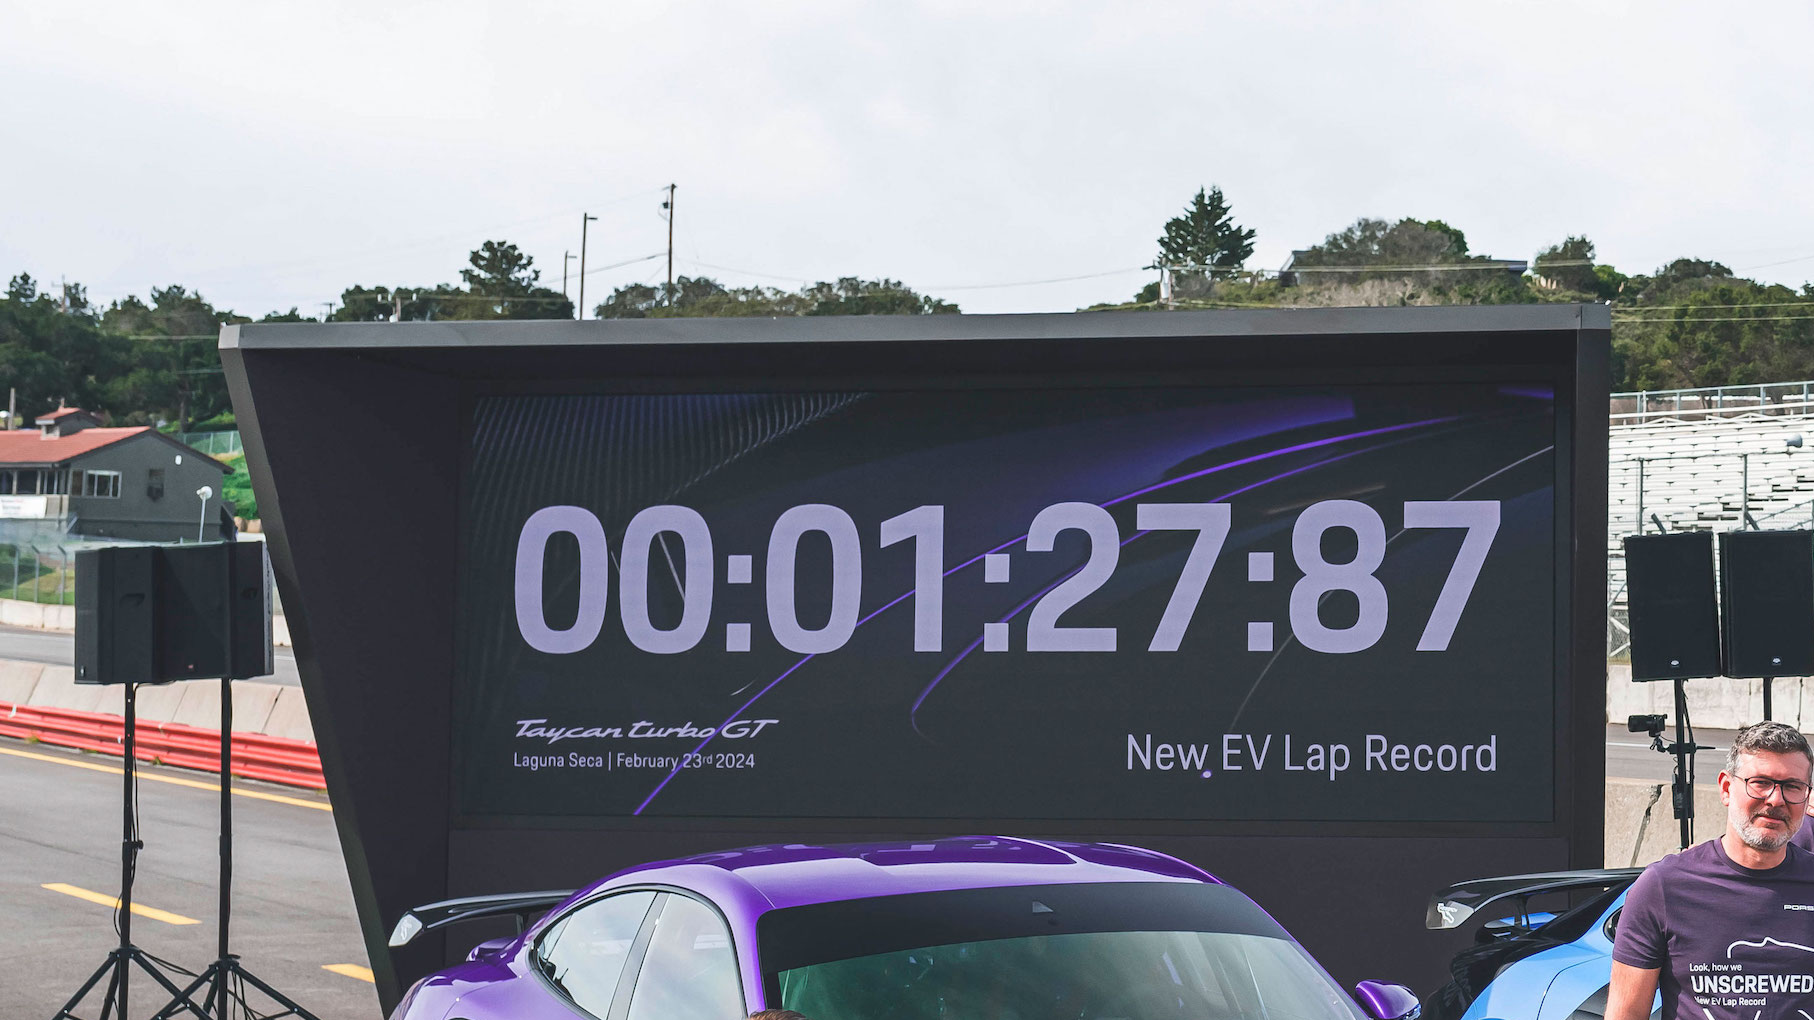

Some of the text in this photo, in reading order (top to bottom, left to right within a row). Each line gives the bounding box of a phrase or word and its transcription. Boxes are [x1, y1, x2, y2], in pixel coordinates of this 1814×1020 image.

[514, 500, 1501, 655] 00:01:27:87
[515, 719, 780, 745] Taycan turbo GT
[513, 752, 565, 771] Laguna
[568, 752, 603, 768] Seca
[616, 752, 679, 771] February
[716, 753, 755, 769] 2024
[1126, 733, 1497, 781] New EV Lap Record
[1689, 963, 1711, 972] Look,
[1712, 963, 1729, 971] how
[1690, 975, 1814, 993] UNSCREWED
[1711, 997, 1721, 1005] EV
[1722, 997, 1737, 1007] Lap
[1738, 997, 1766, 1006] Record
